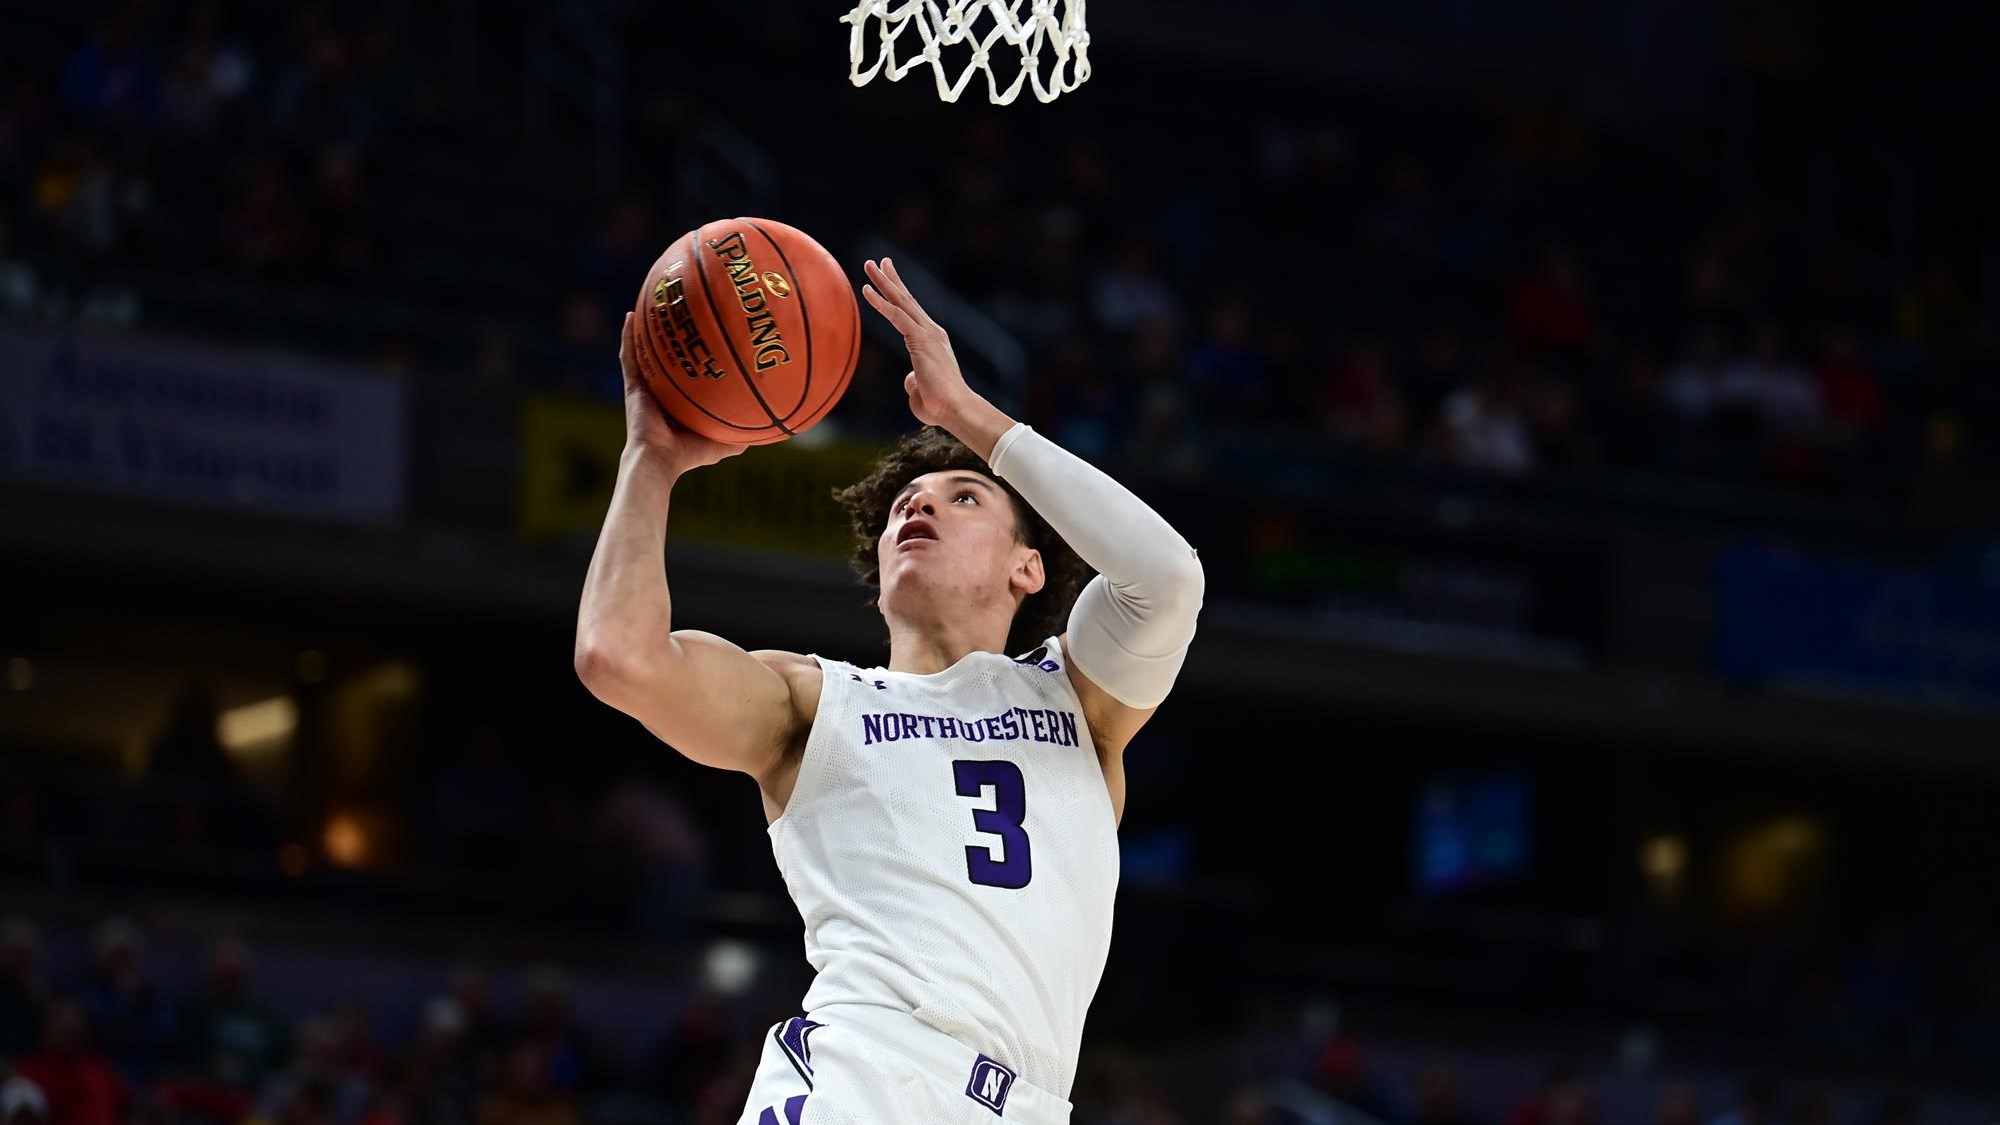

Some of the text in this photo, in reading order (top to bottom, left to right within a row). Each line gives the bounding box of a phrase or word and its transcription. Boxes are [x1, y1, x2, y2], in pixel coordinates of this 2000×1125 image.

[663, 260, 727, 380] LEGACY
[706, 232, 792, 373] SPALDING
[862, 707, 1080, 748] NORTHWESTERN
[952, 759, 1032, 889] 3
